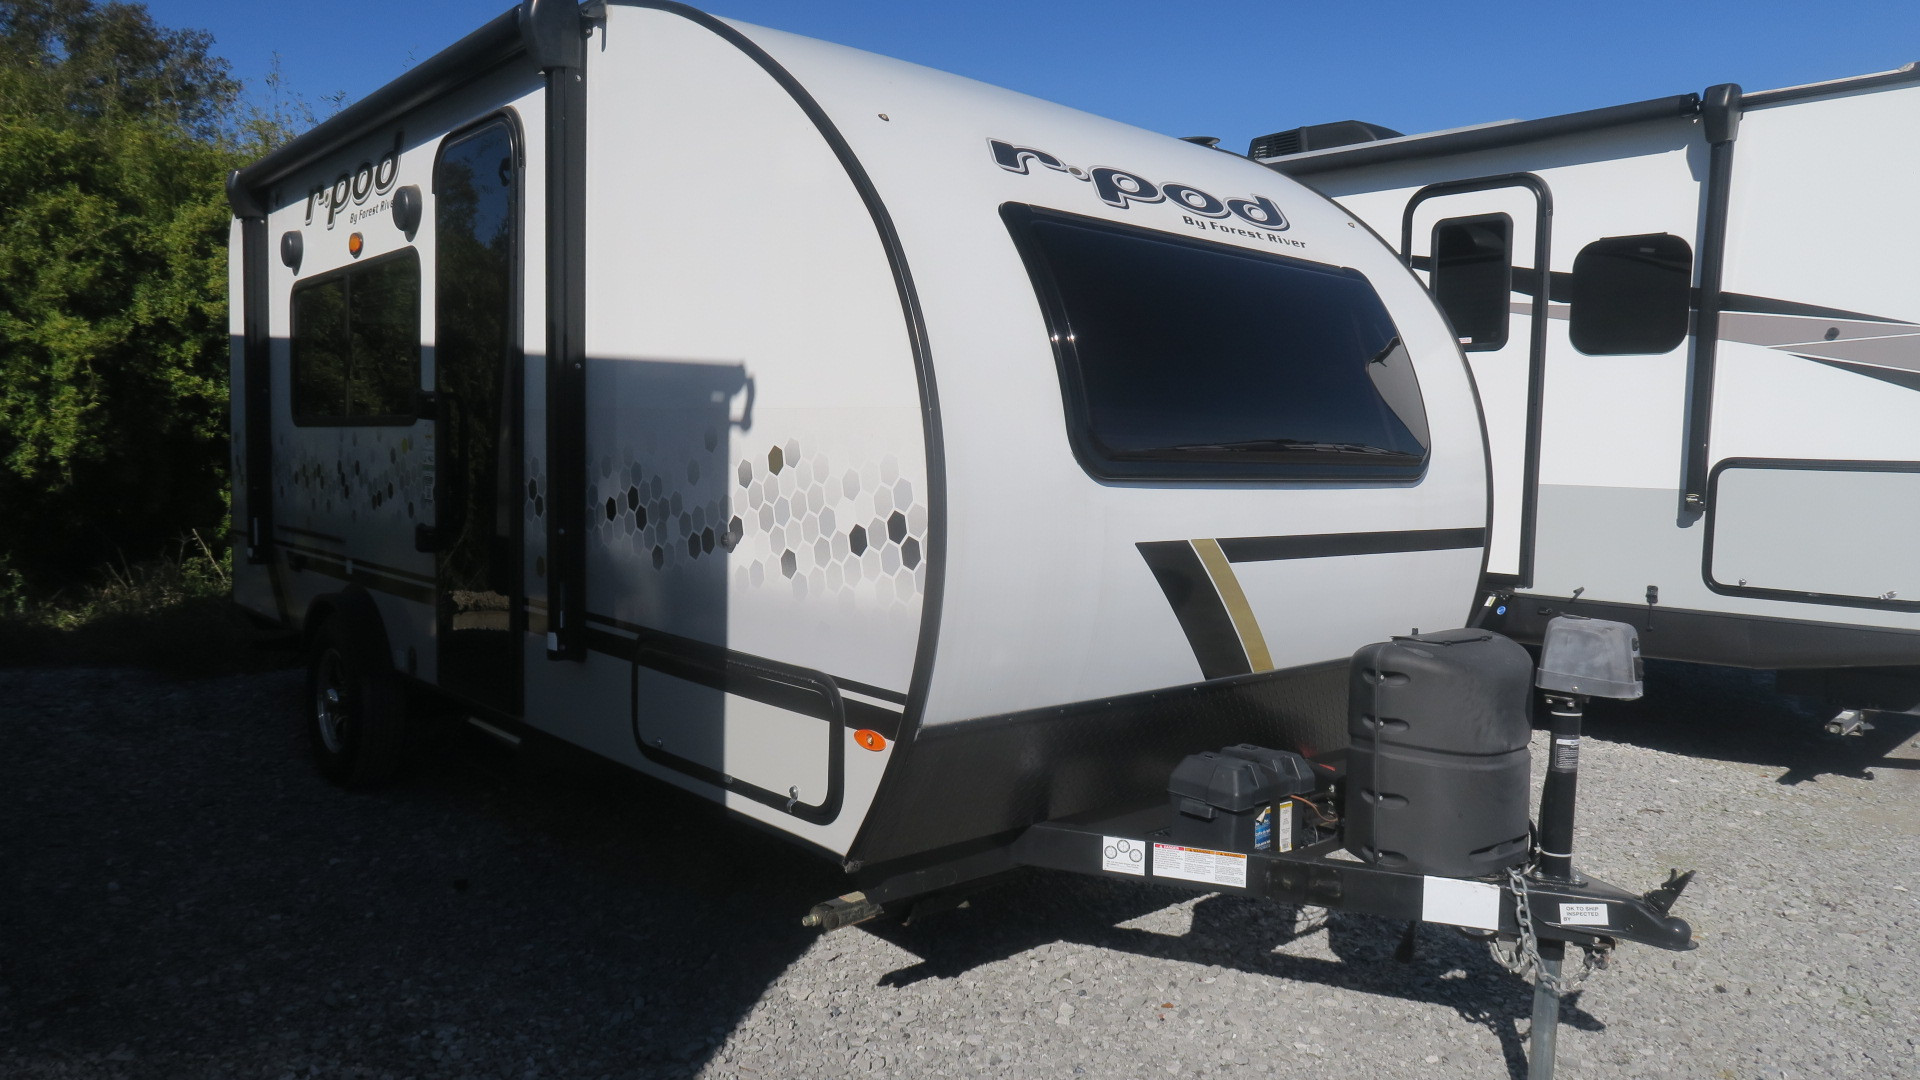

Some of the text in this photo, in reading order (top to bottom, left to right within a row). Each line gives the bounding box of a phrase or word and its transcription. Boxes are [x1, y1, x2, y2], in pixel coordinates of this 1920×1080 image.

[349, 199, 394, 225] By Forest Rive
[1182, 215, 1306, 249] By Forest River
